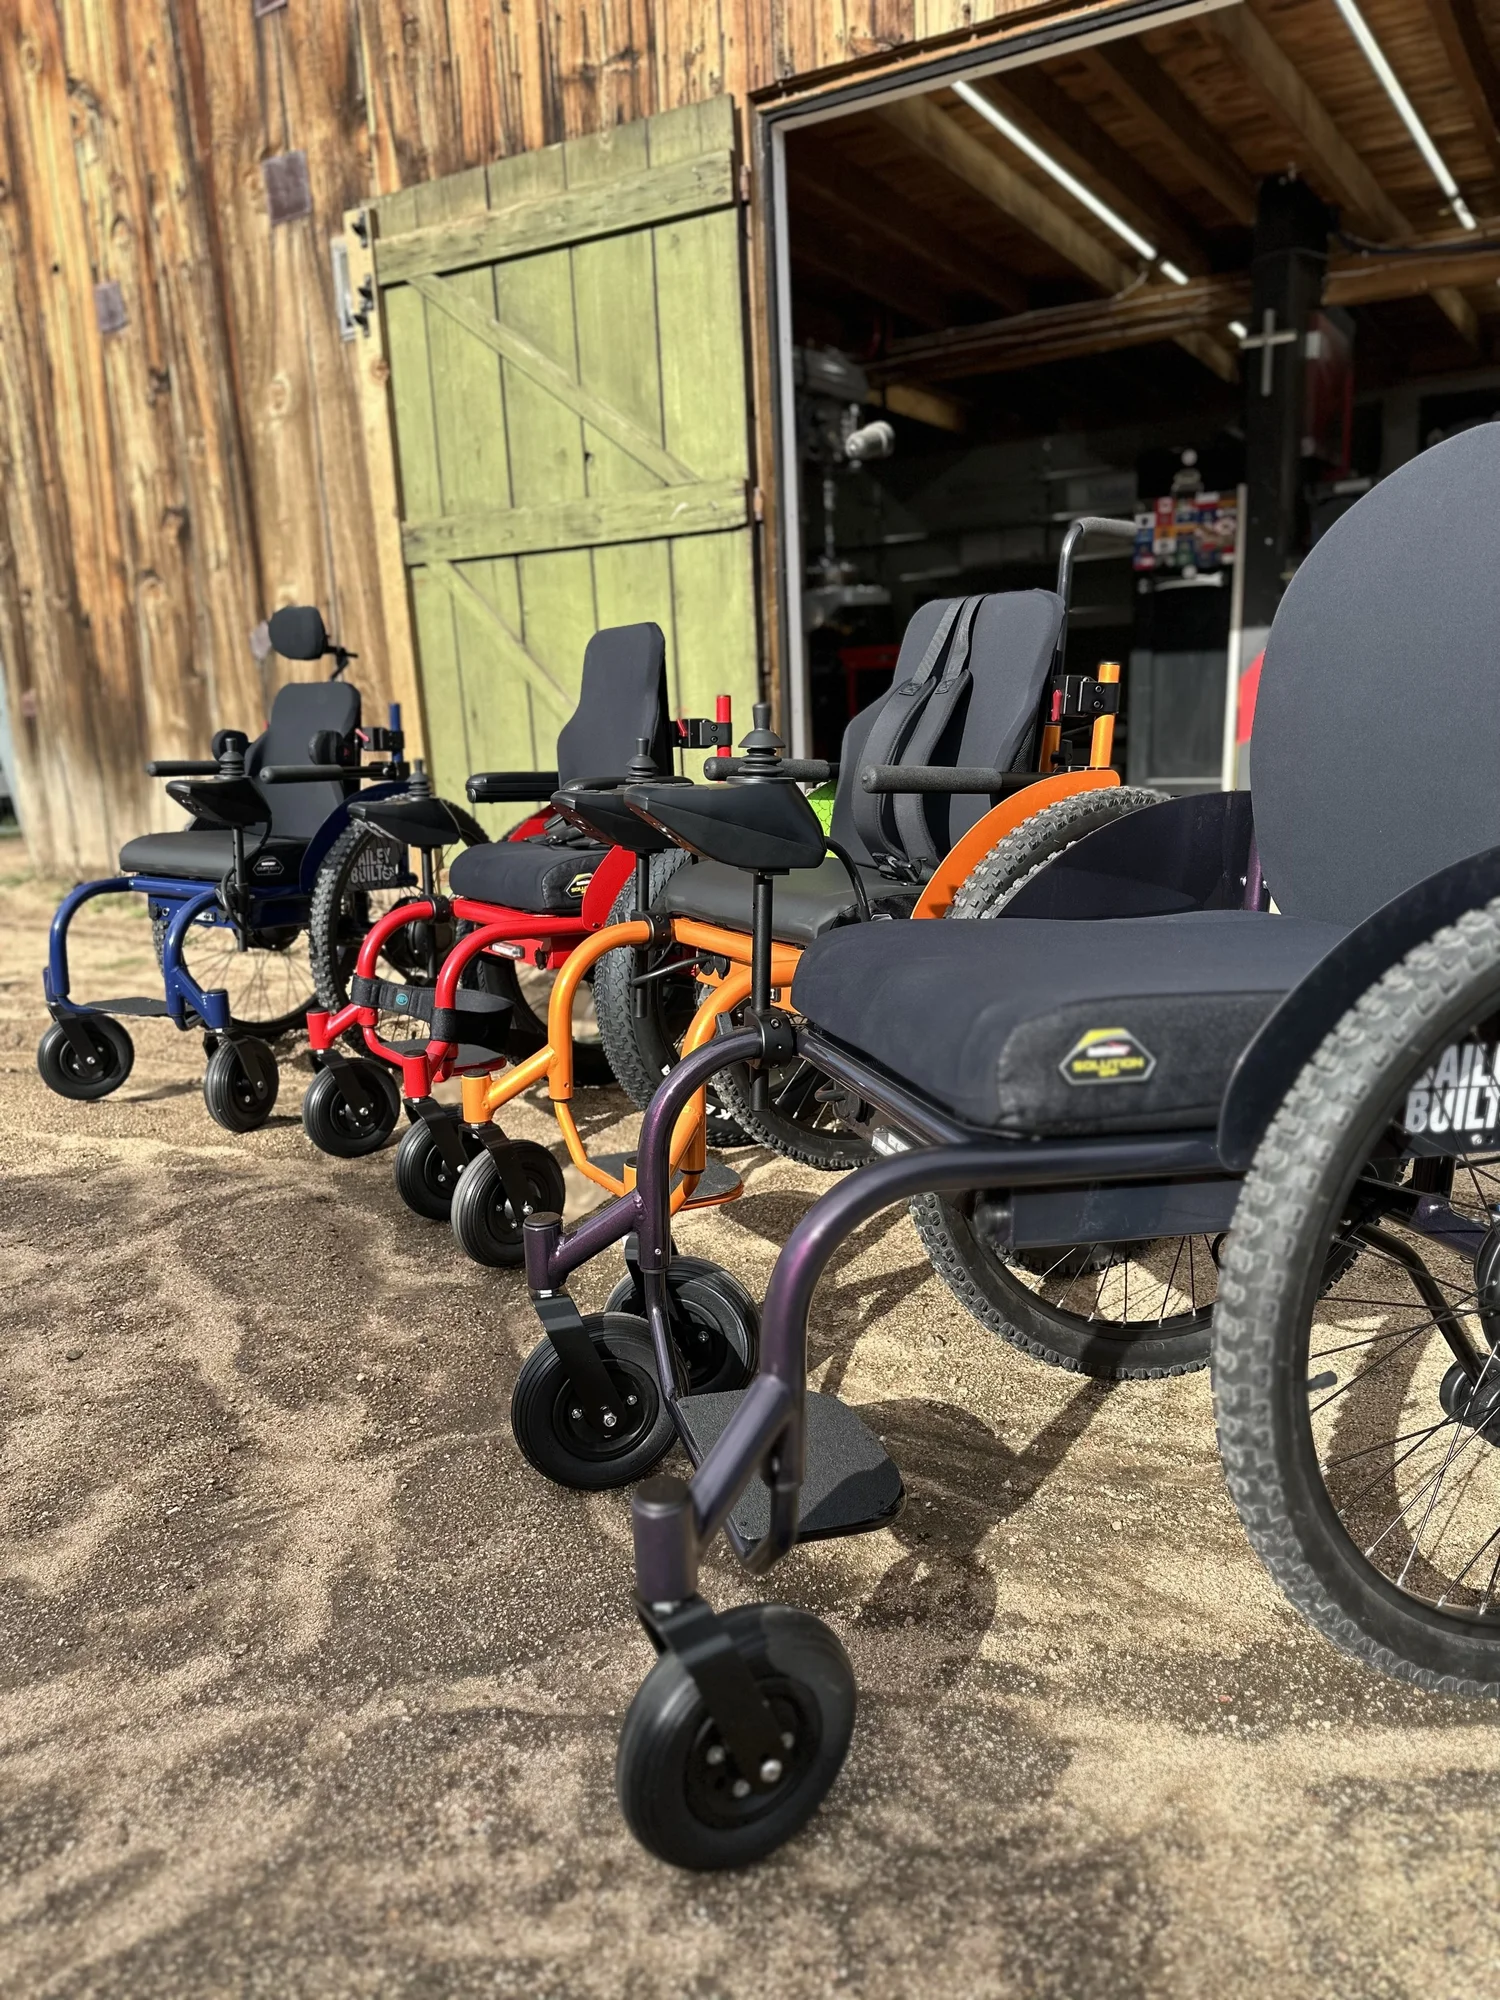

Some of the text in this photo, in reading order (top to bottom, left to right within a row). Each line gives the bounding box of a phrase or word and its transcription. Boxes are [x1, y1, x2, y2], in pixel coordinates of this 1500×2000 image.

[353, 847, 390, 866] AILEY
[350, 865, 382, 883] BUILT
[1072, 1057, 1144, 1073] SOLUTION
[1412, 1043, 1500, 1089] AIL
[1404, 1087, 1500, 1133] BUILT
